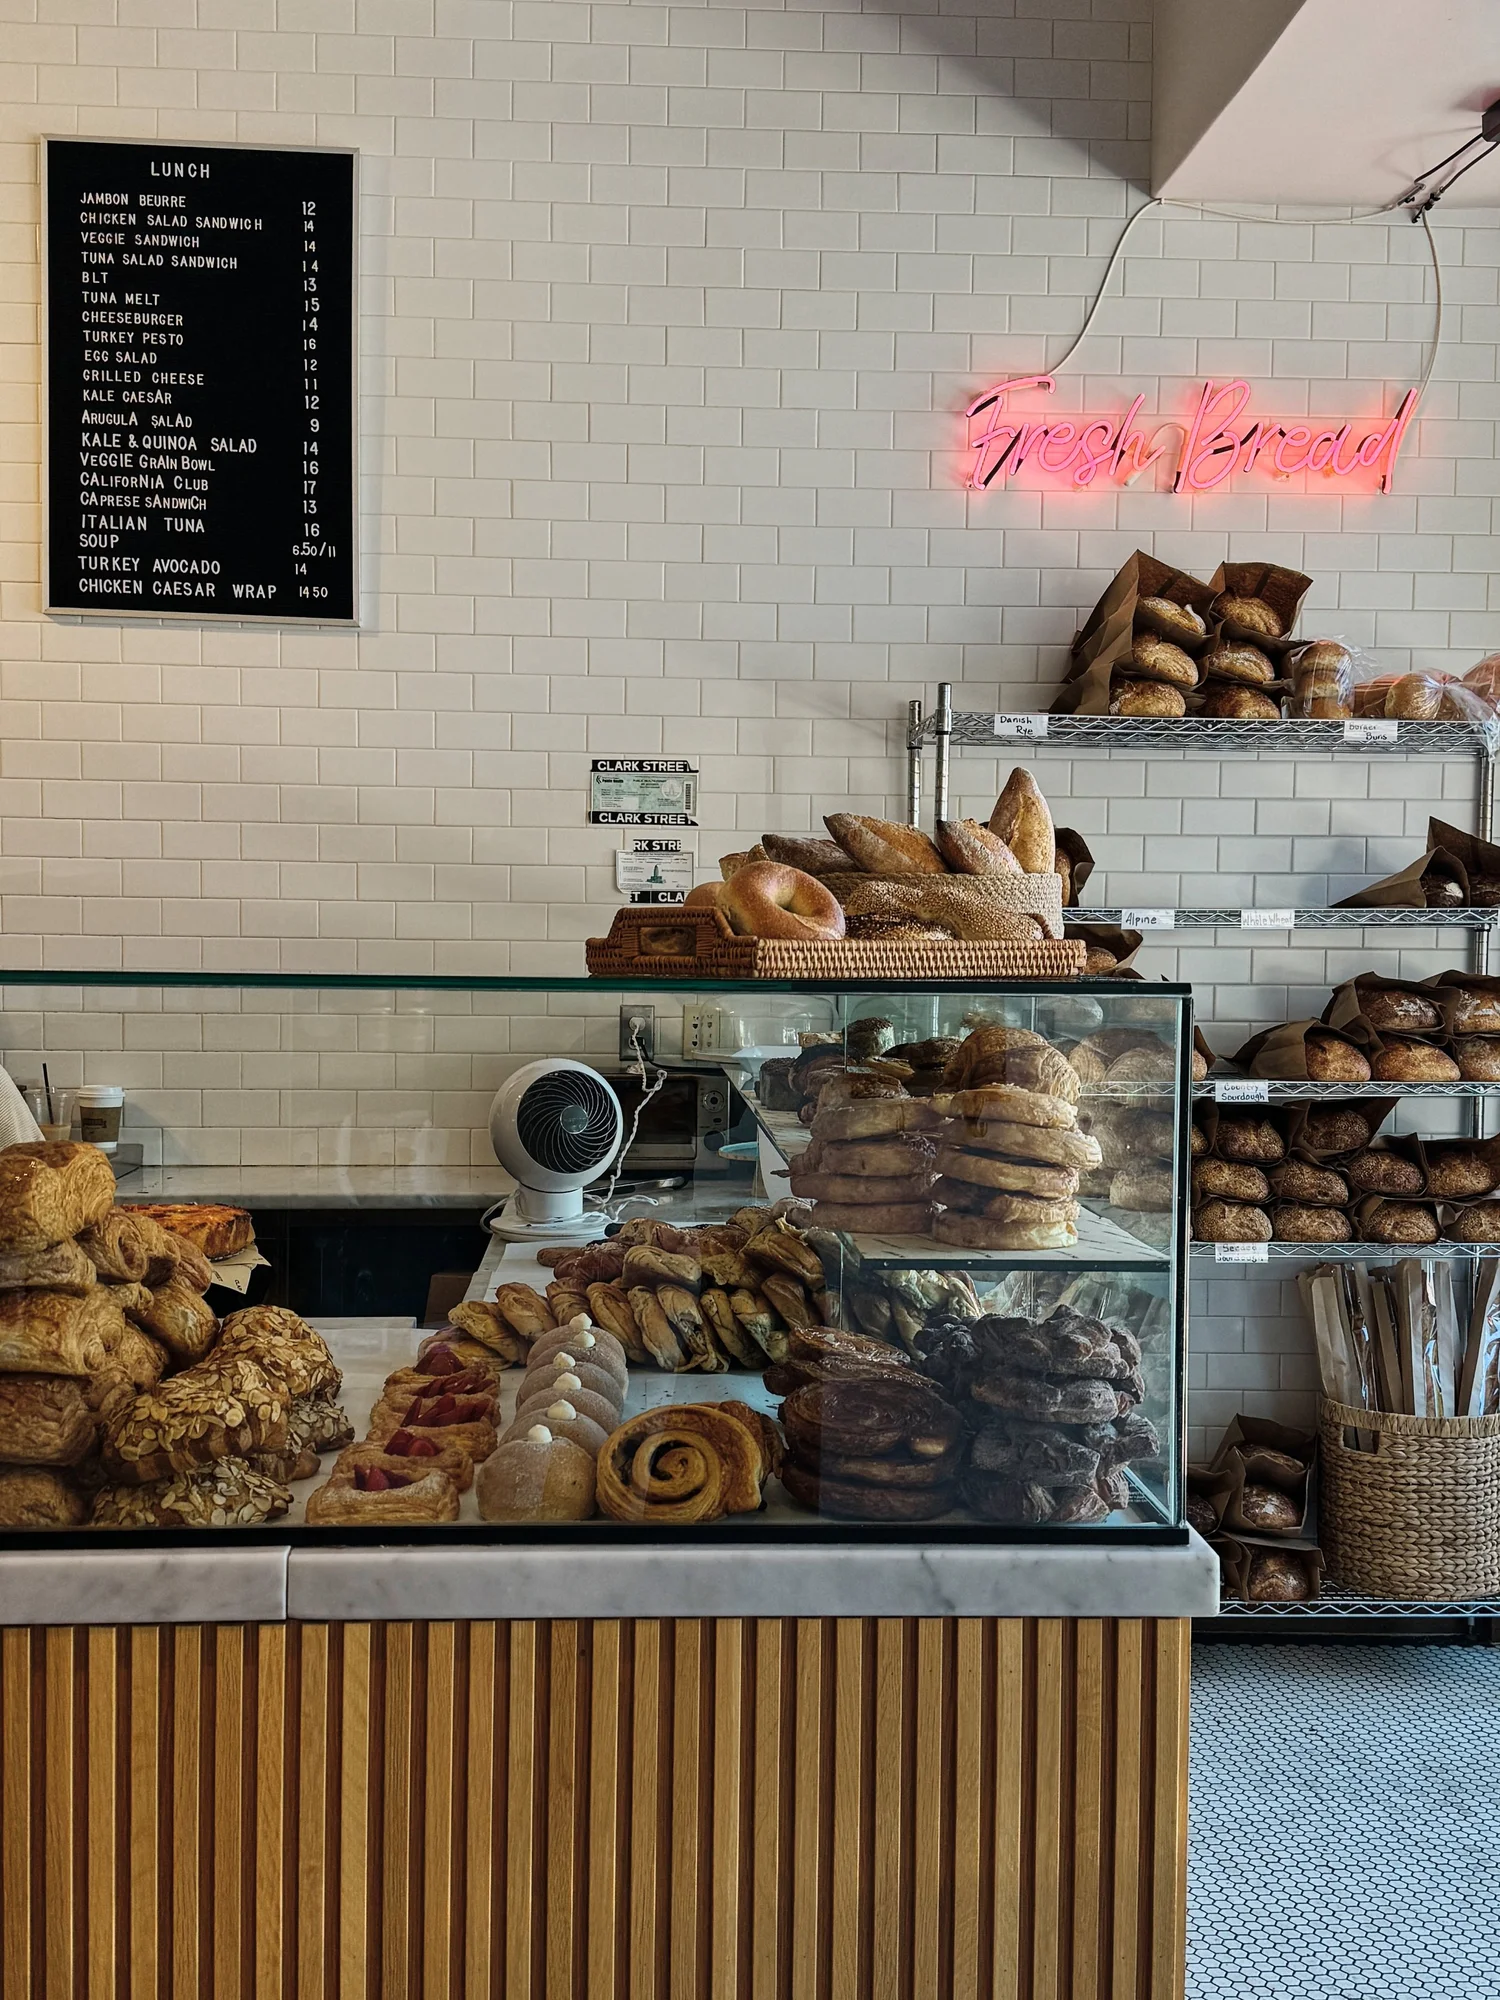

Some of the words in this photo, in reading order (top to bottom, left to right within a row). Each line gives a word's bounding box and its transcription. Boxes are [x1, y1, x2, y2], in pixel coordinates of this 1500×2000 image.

[151, 162, 209, 178] LUNCH
[80, 192, 128, 205] JAMBON
[140, 195, 186, 207] BEURRE
[302, 202, 315, 215] 12
[80, 212, 135, 225] CHICKEN
[147, 215, 187, 227] SALAD
[196, 217, 262, 230] SANDWICH
[304, 220, 314, 232] 14
[81, 232, 125, 244] VEGGIE
[135, 234, 199, 248] SANDWICH
[305, 241, 315, 252] 14
[81, 252, 114, 264] TUNA
[123, 254, 163, 266] SALAD
[172, 255, 237, 269] SANDWICH
[303, 260, 318, 272] 14
[82, 272, 108, 283] BLT
[304, 278, 316, 291] 13
[82, 291, 117, 304] TUNA
[126, 293, 160, 305] MELT
[305, 298, 319, 312] 15
[82, 311, 182, 326] CHEESEBURGER
[303, 317, 318, 331] 14
[83, 330, 134, 343] TURKEY
[143, 333, 183, 345] PESTO
[304, 338, 316, 350] 16
[85, 350, 108, 362] EGG
[116, 352, 157, 363] SALAD
[304, 359, 317, 371] 12
[83, 370, 140, 382] GRILLED
[152, 372, 204, 385] CHEESE
[305, 379, 317, 390] 11
[84, 389, 114, 401] KALE
[305, 396, 319, 409] 12
[311, 419, 319, 432] 9
[966, 375, 1166, 491] Fresh
[1173, 379, 1418, 494] Bread
[82, 432, 121, 447] KALE
[129, 434, 139, 448] &
[143, 435, 197, 450] QUINOA
[211, 438, 256, 453] SALAD
[304, 442, 318, 455] 14
[80, 452, 133, 467] VEGGIE
[303, 461, 318, 474] 16
[174, 476, 208, 490] CLUB
[304, 481, 316, 494] 17
[80, 492, 140, 507] CAPRESE
[303, 500, 317, 513] 13
[82, 514, 146, 530] ITALIAN
[164, 518, 204, 532] TUNA
[305, 523, 319, 537] 16
[80, 534, 119, 548] SOUP
[78, 556, 139, 571] TURKEY
[153, 559, 220, 574] AVOCADO
[295, 563, 306, 575] 14
[79, 578, 142, 594] CHICKEN
[153, 581, 215, 597] CAESAR
[232, 584, 276, 598] WRAP
[1000, 715, 1032, 724] Danish
[1016, 725, 1034, 737] Rye
[1365, 731, 1388, 741] Buns
[597, 760, 640, 771] CLARK
[599, 812, 641, 824] CLARK
[1125, 911, 1157, 927] Alpine
[1221, 1092, 1265, 1103] Sourdough
